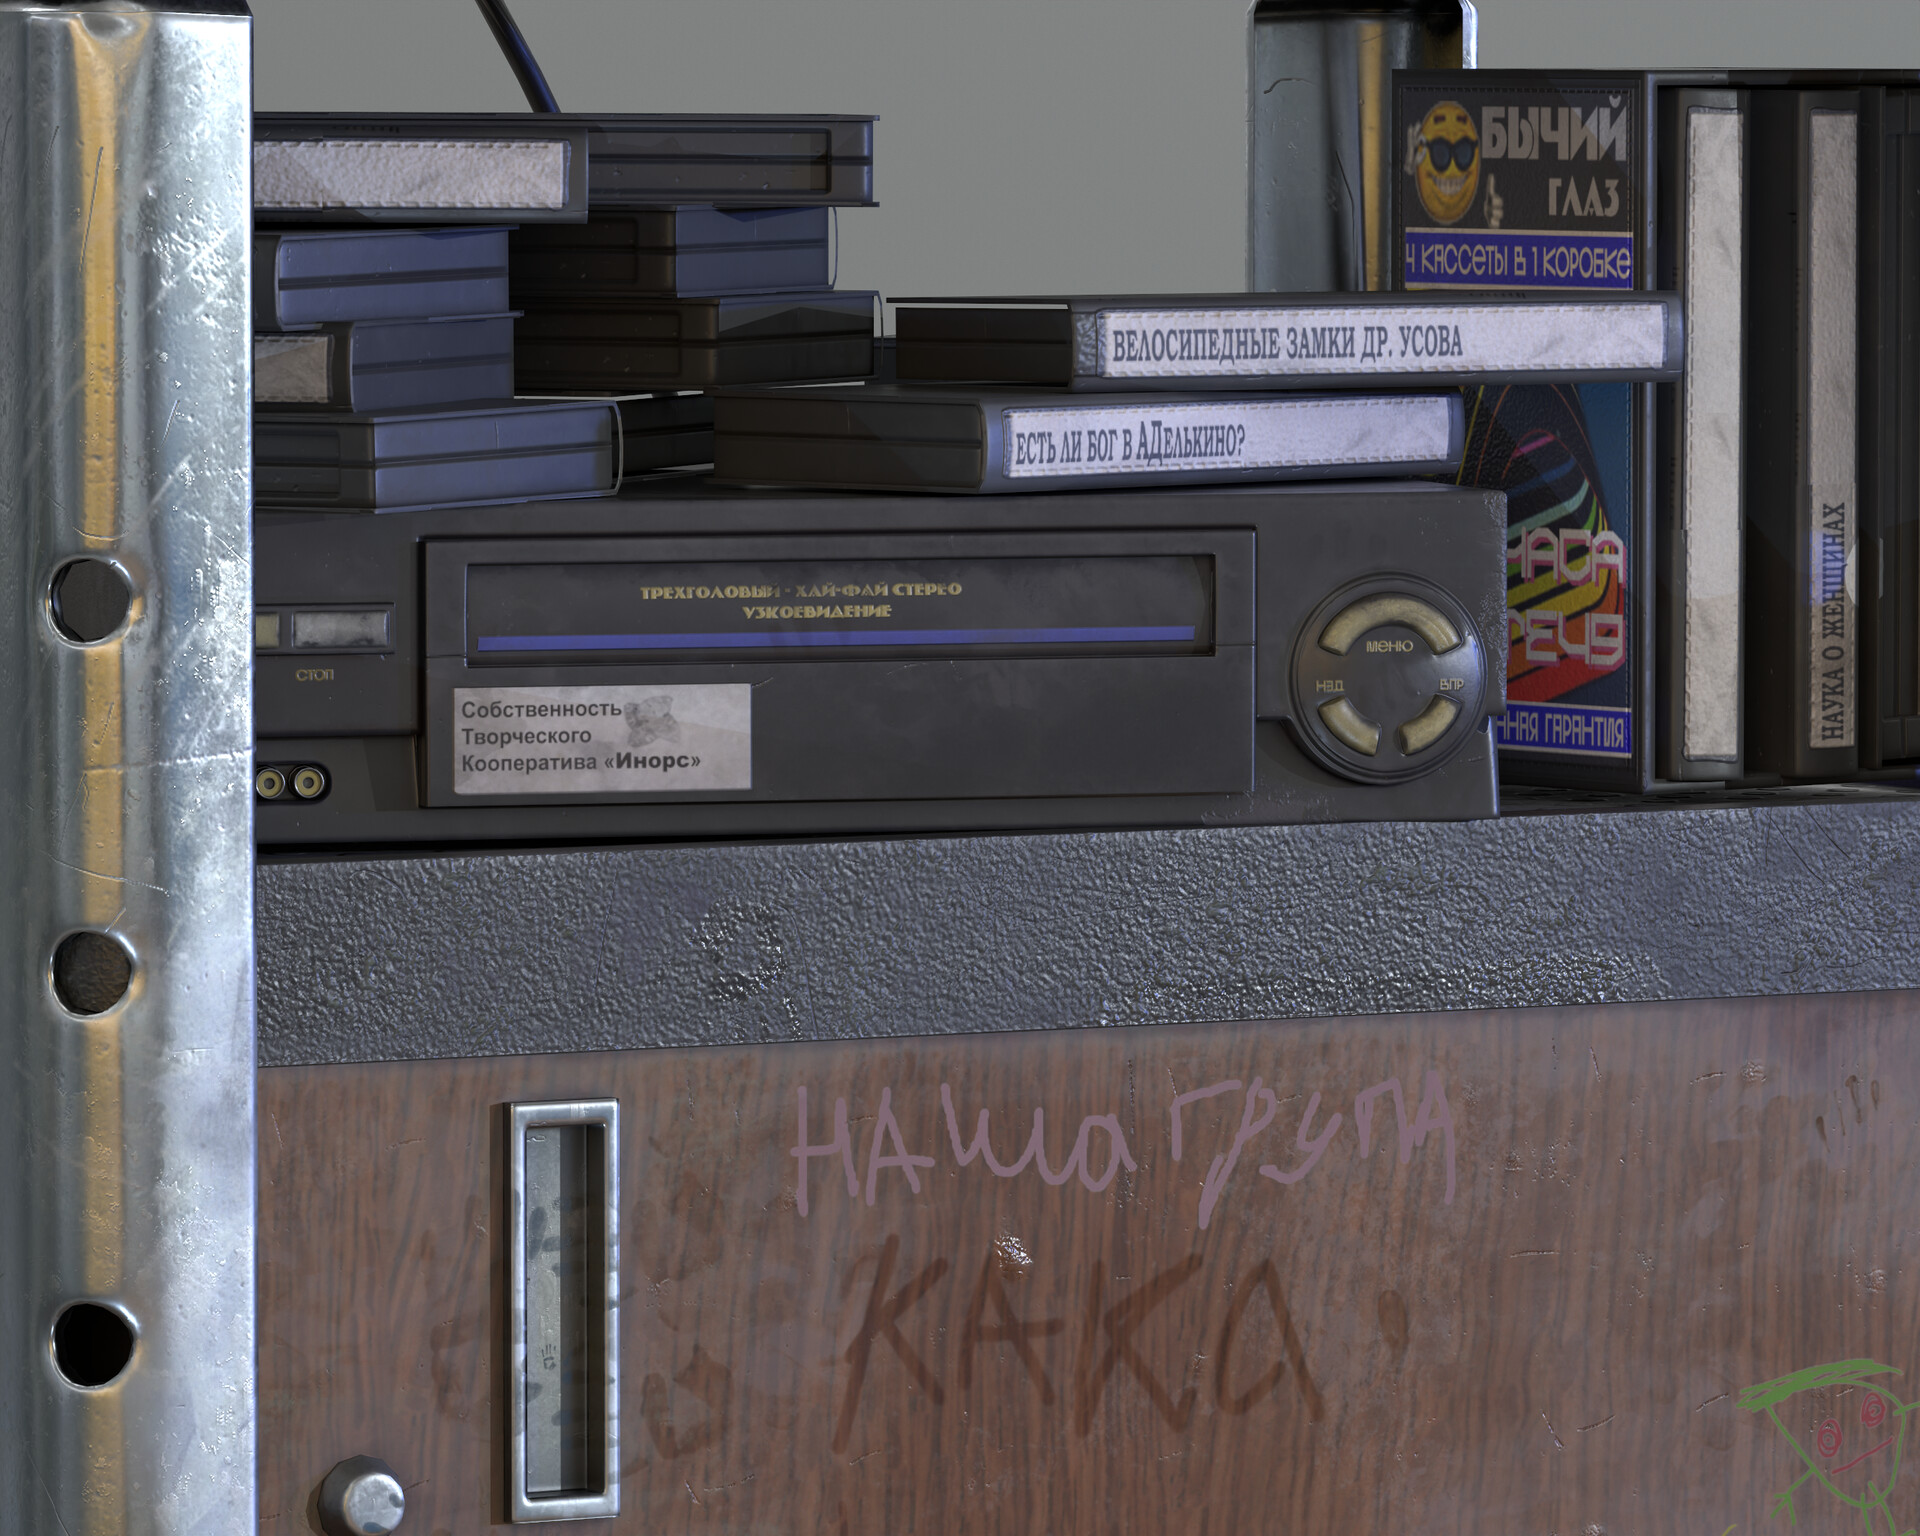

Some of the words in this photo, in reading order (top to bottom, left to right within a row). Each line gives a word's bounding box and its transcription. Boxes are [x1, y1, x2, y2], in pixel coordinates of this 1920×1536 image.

[1482, 94, 1628, 161] БЫЧИЙ
[1548, 176, 1620, 217] ГЛАЗ
[1514, 246, 1527, 276] В
[1531, 246, 1538, 276] 1
[1112, 327, 1281, 366] ВЕЛОСИПЕДНЫЕ
[1286, 326, 1355, 360] ЗАМКИ
[1360, 326, 1392, 363] ДР.
[1400, 324, 1463, 357] УСОВА
[1015, 431, 1056, 465] ЕСТЬ
[1059, 430, 1082, 463] ЛИ
[1087, 429, 1117, 462] БОГ
[1122, 429, 1132, 461] В
[1822, 502, 1848, 639] ЖЕНЩИНАХ
[640, 583, 781, 600] ТРЕХГОЛОВЫЙ
[795, 581, 889, 598] ХАЙ-ФАЙ
[892, 581, 963, 597] СТЕРЕО
[742, 604, 892, 619] УЗКОЕВИДЕНИЕ
[1366, 640, 1414, 653] МЕНЮ
[1822, 645, 1844, 660] О
[295, 668, 334, 682] СТОП
[1440, 678, 1464, 691] ВПР
[461, 700, 622, 719] Собственность
[1822, 667, 1844, 740] НАУКА
[462, 727, 592, 748] Творческого
[1545, 713, 1624, 748] ГАРАНТИЯ
[462, 754, 597, 775] Кооператива
[604, 751, 701, 772] «Инорс»
[1170, 1070, 1458, 1229] ГРУПА
